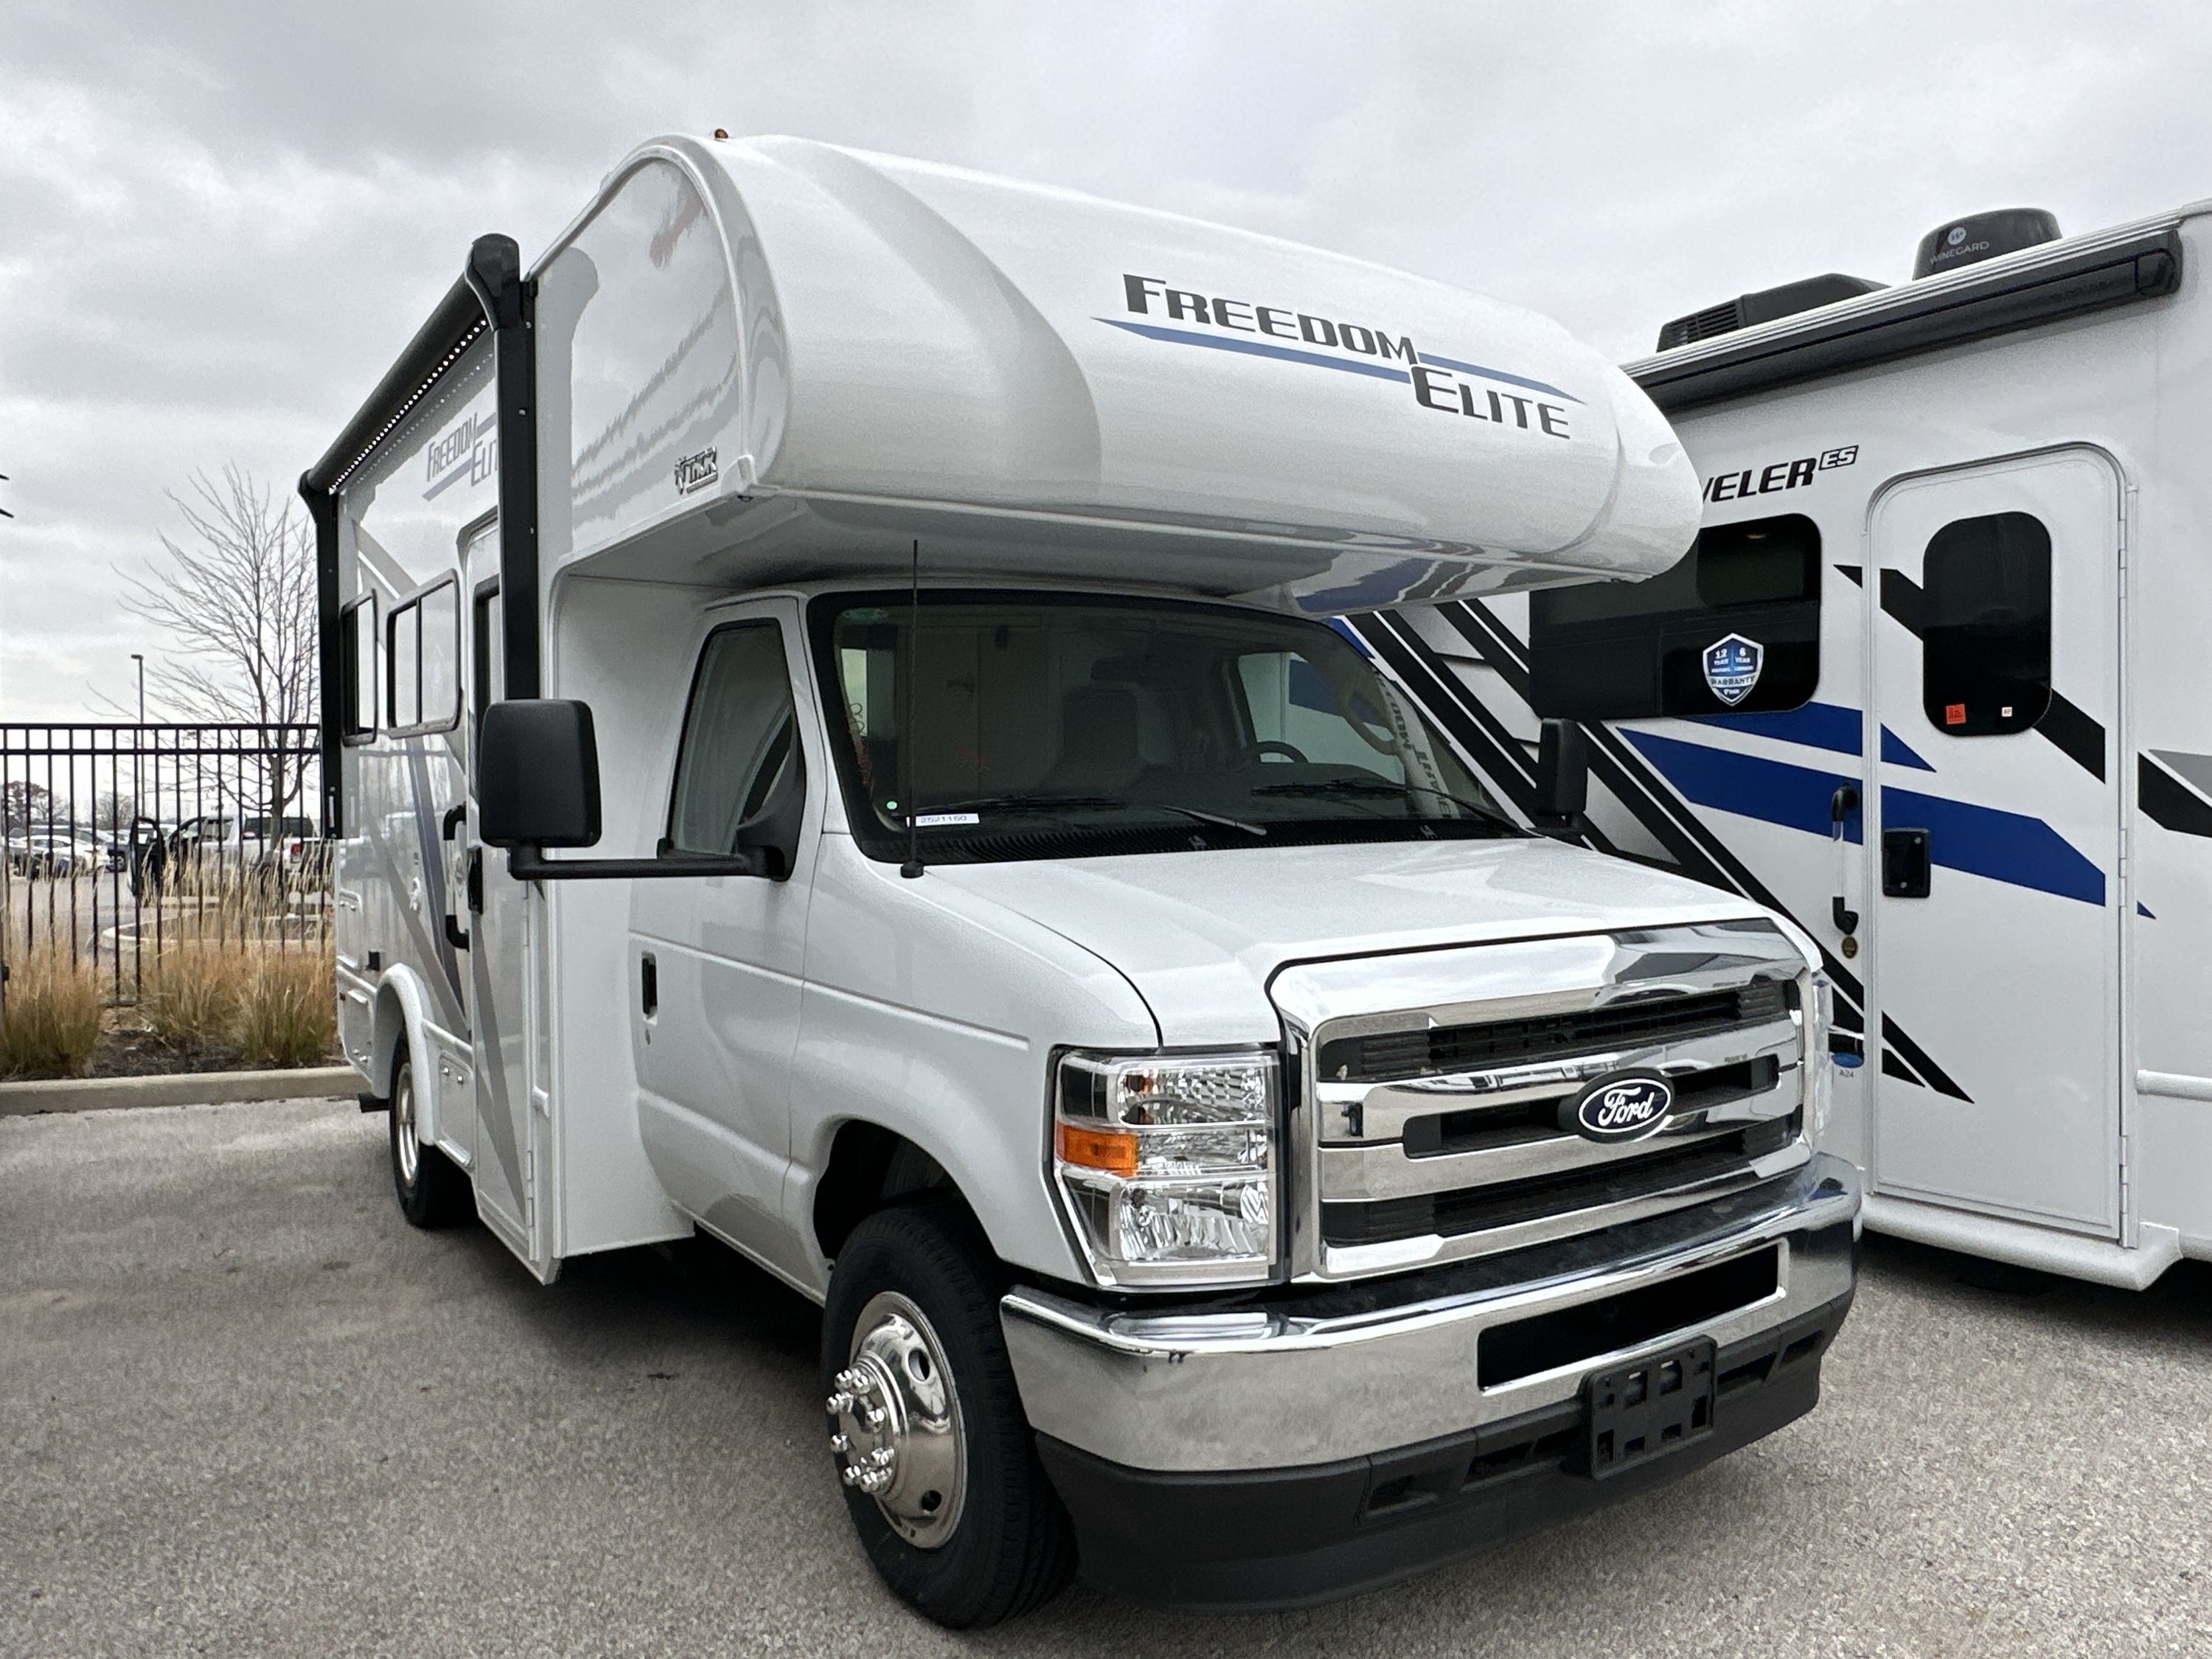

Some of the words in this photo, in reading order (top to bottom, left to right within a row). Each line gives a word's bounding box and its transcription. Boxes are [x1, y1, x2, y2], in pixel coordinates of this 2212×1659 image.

[1123, 274, 1418, 365] FREEDOM
[1411, 365, 1570, 440] ELITE
[471, 439, 498, 487] ELIT
[1818, 445, 1859, 470] ES
[1597, 1086, 1655, 1127] Ford
